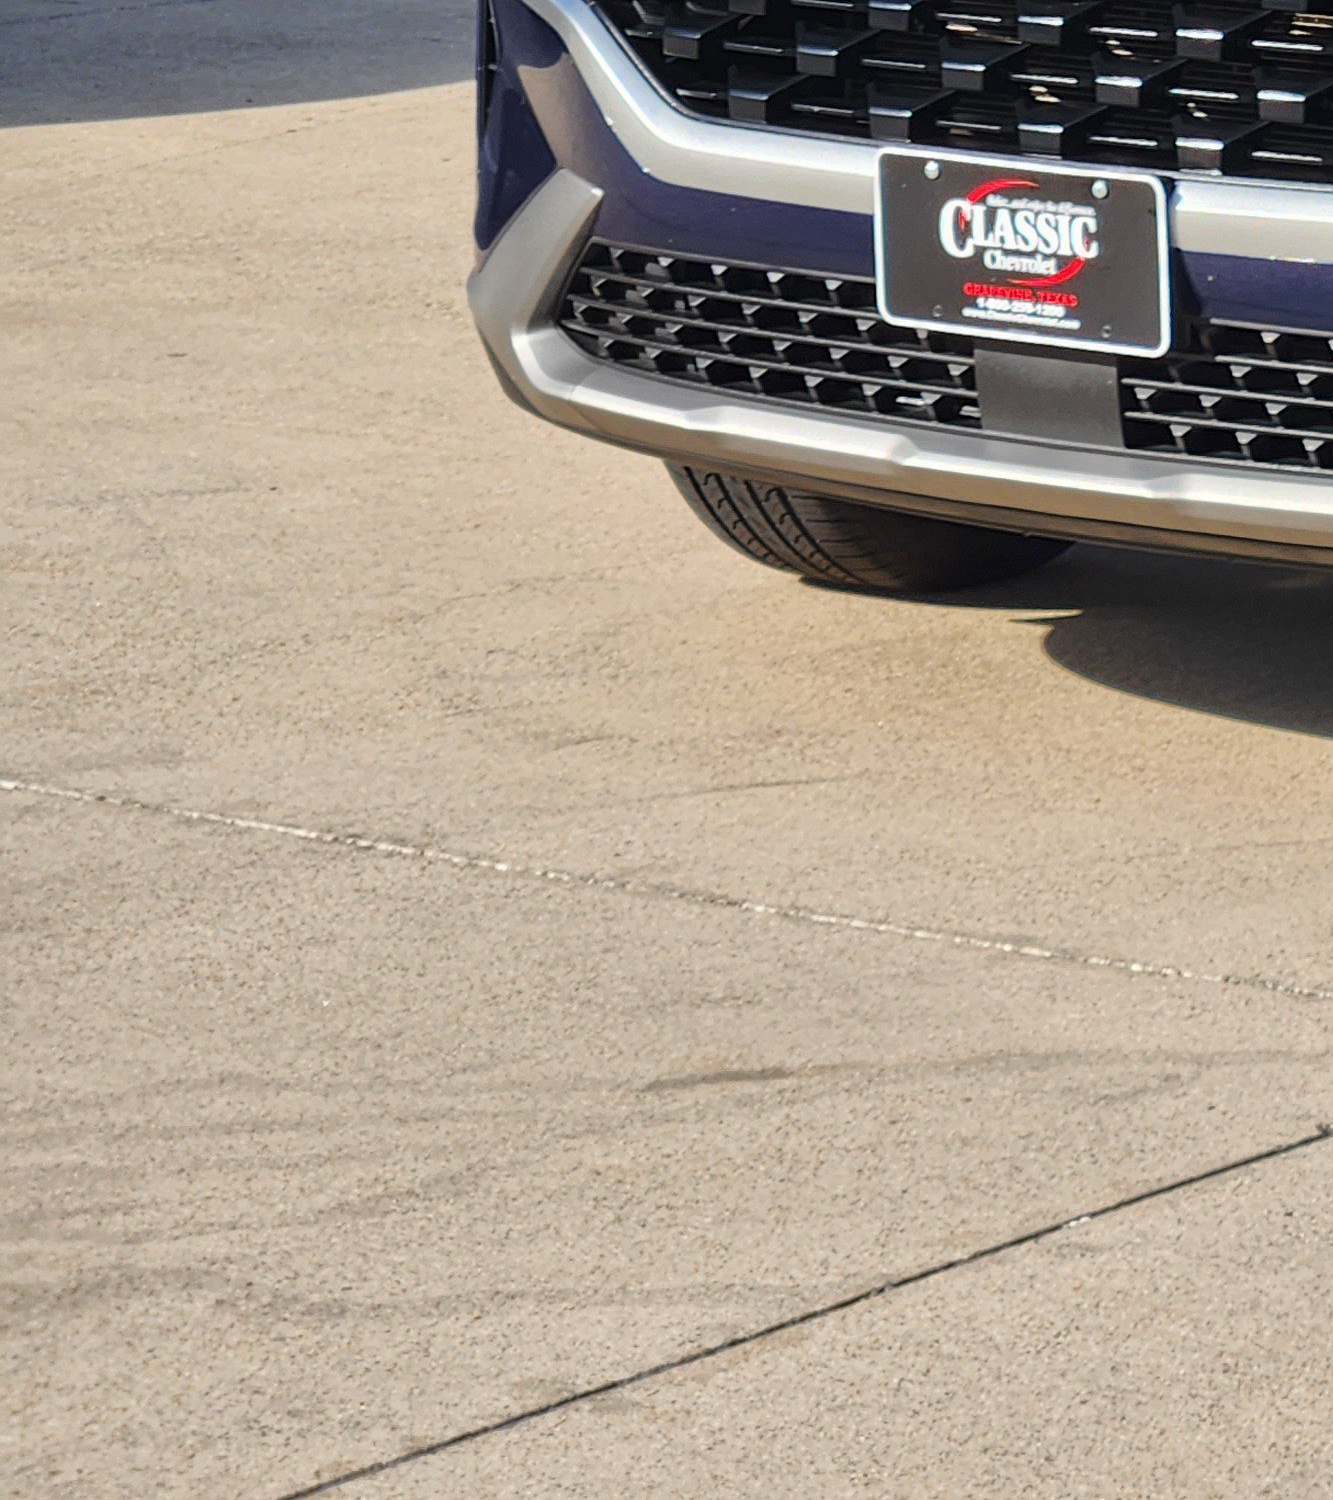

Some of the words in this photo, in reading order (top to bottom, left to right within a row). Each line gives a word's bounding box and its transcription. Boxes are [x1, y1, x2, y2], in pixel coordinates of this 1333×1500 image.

[939, 197, 1098, 258] CLASSIC
[983, 248, 1057, 275] Chevrolet
[1037, 290, 1078, 307] TEXAS
